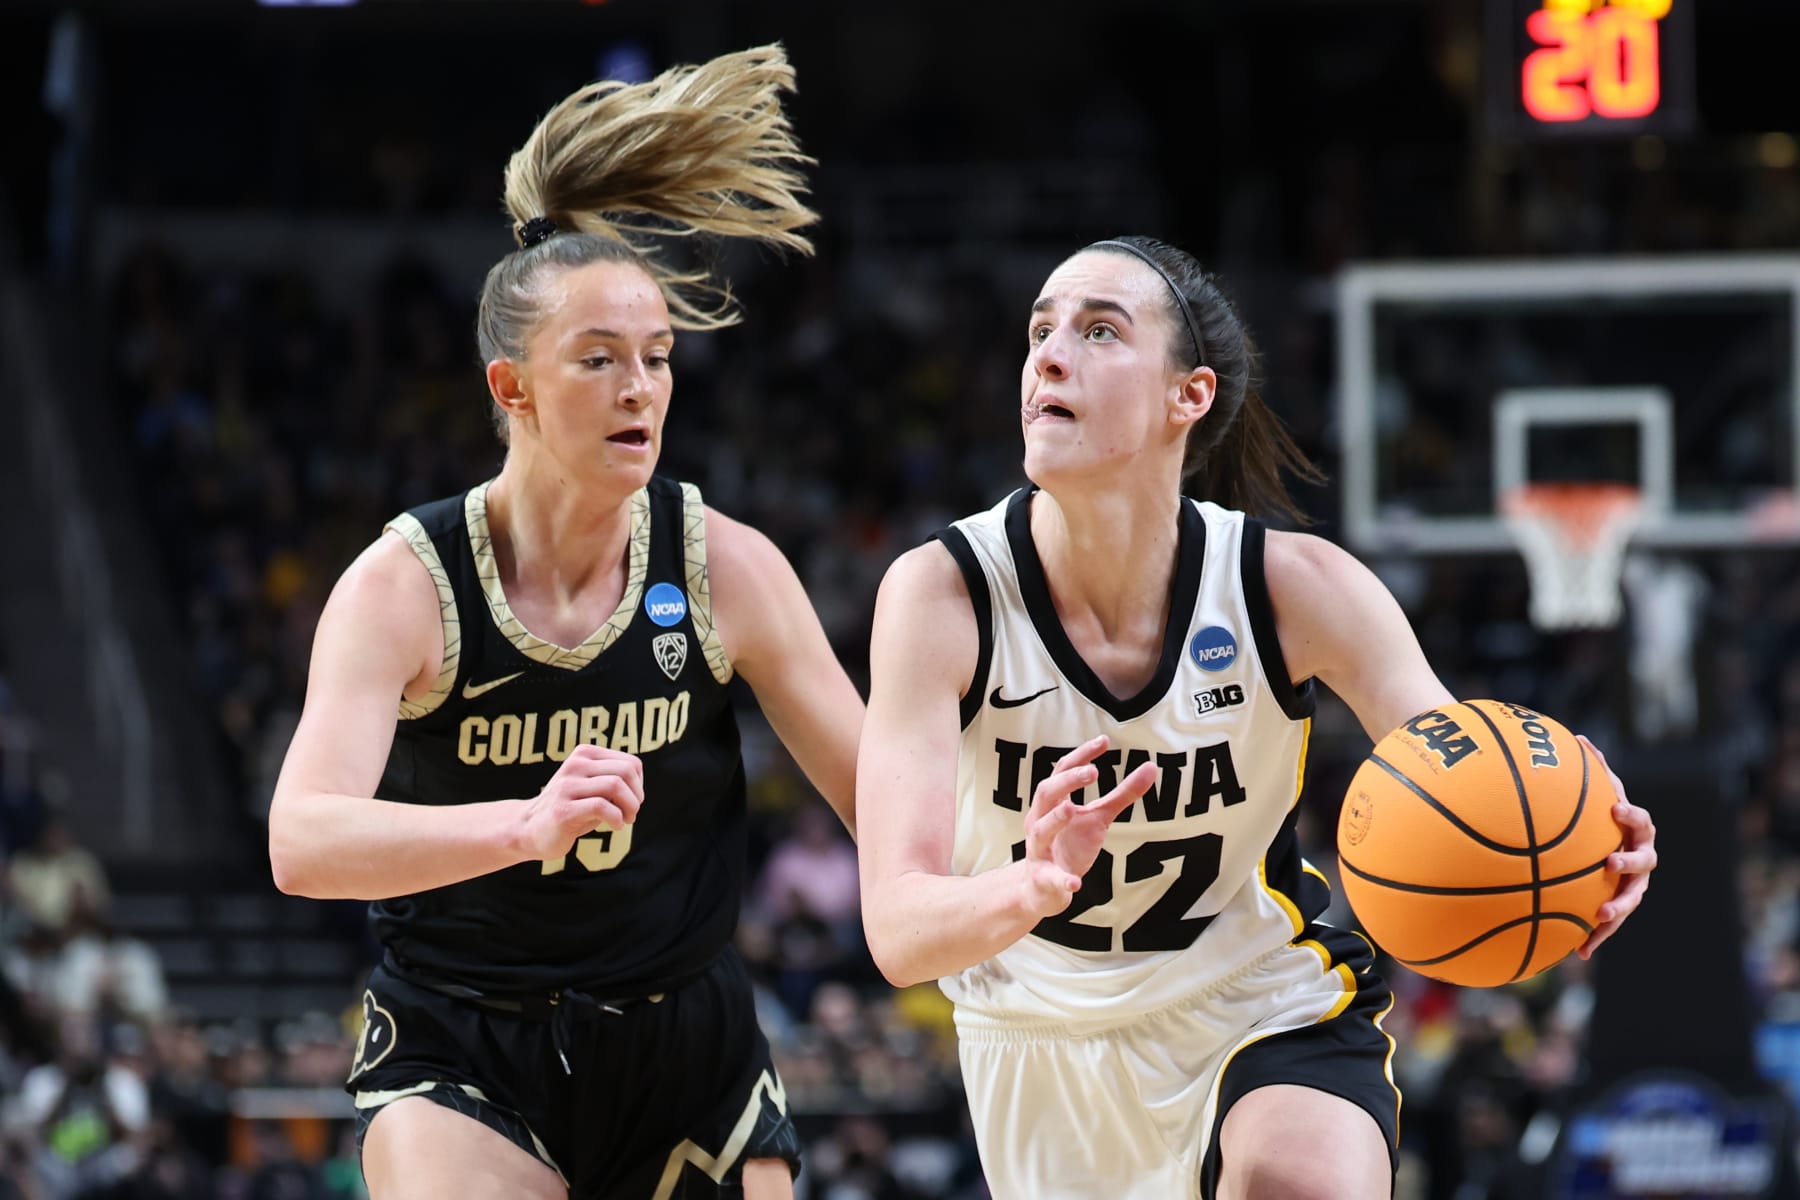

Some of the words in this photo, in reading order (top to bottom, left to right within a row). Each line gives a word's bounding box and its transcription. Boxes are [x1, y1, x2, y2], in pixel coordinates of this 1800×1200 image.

[1522, 6, 1660, 122] 20
[651, 602, 684, 617] NCAA
[655, 636, 685, 662] PAC
[664, 652, 680, 670] 12
[1199, 645, 1235, 662] NCAA
[458, 690, 690, 766] COLORADO
[541, 787, 634, 876] 5
[1012, 832, 1224, 952] 22
